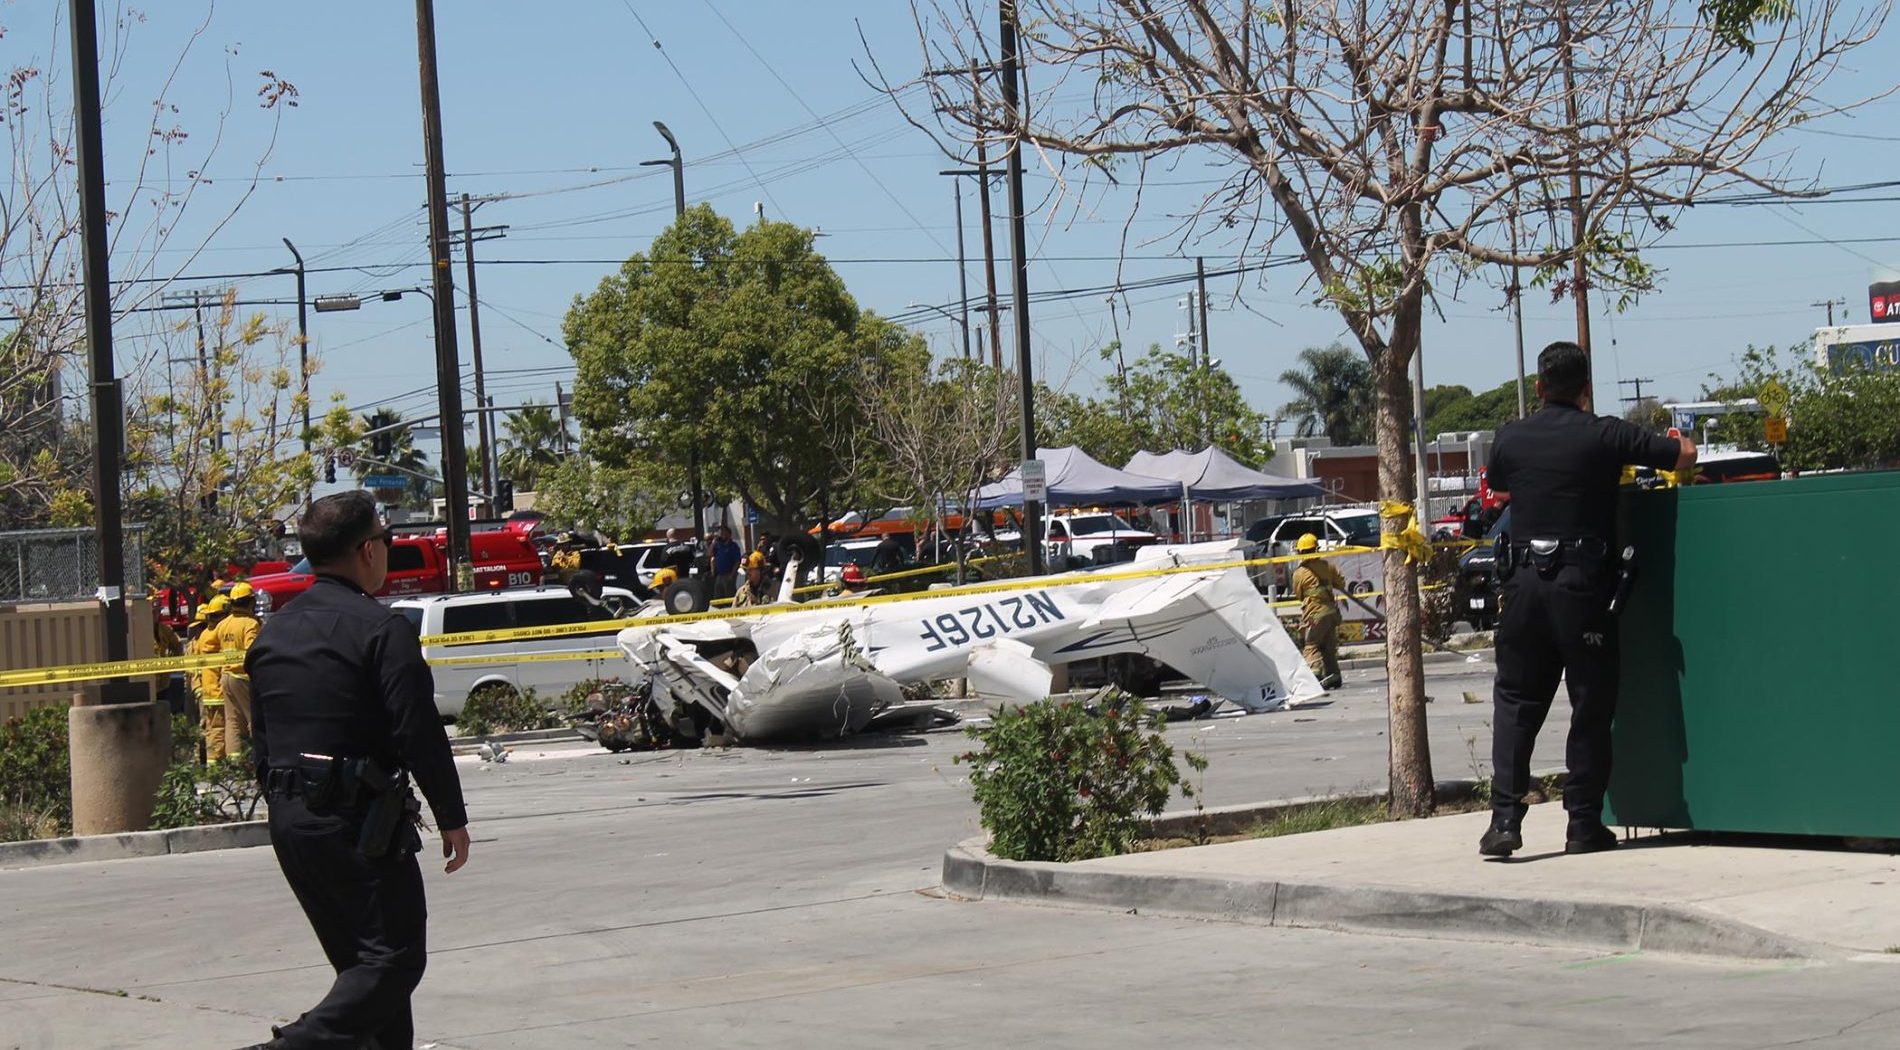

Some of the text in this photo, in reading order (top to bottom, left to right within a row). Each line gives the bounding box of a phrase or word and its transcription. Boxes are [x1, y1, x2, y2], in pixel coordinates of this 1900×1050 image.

[1886, 303, 1900, 316] AT
[473, 565, 507, 574] BATTALION
[508, 572, 532, 585] B10
[920, 590, 1065, 652] N2126F
[459, 634, 475, 642] LINEA
